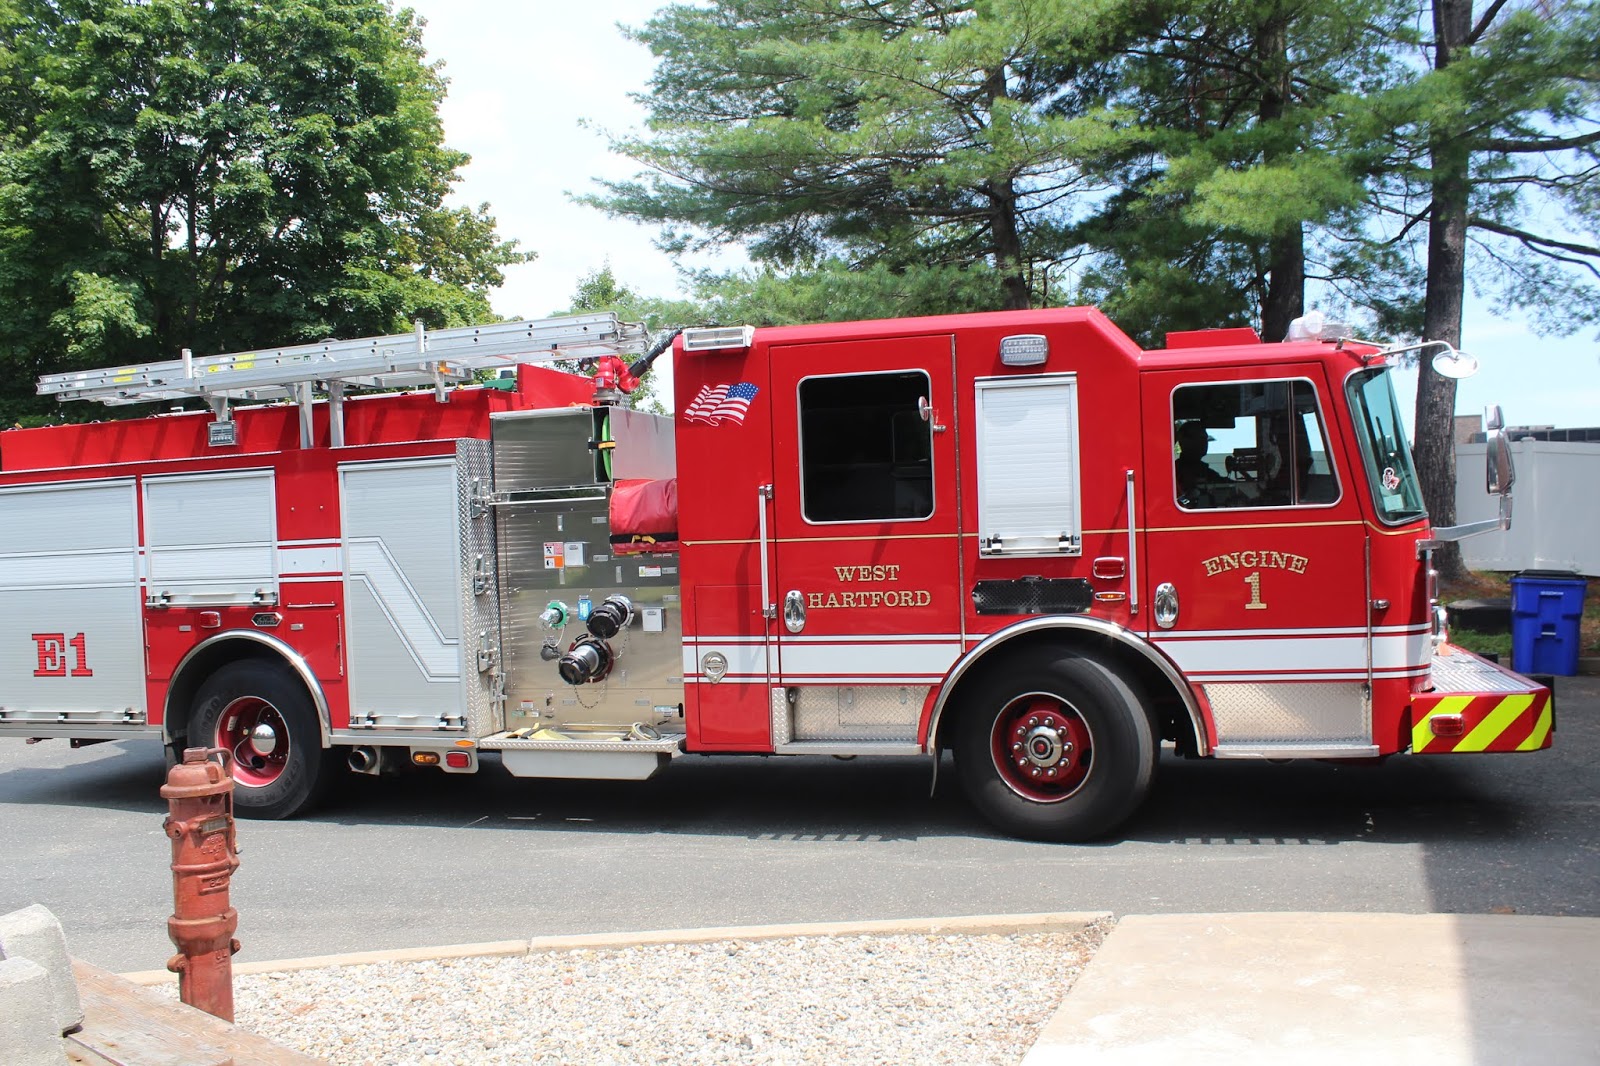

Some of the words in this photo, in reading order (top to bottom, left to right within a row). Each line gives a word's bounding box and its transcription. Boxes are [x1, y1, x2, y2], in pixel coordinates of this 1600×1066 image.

[833, 564, 900, 582] WEST
[1201, 550, 1309, 577] ENGINE
[807, 590, 931, 609] HARTFORD
[1244, 571, 1267, 610] 1
[31, 632, 93, 677] E1
